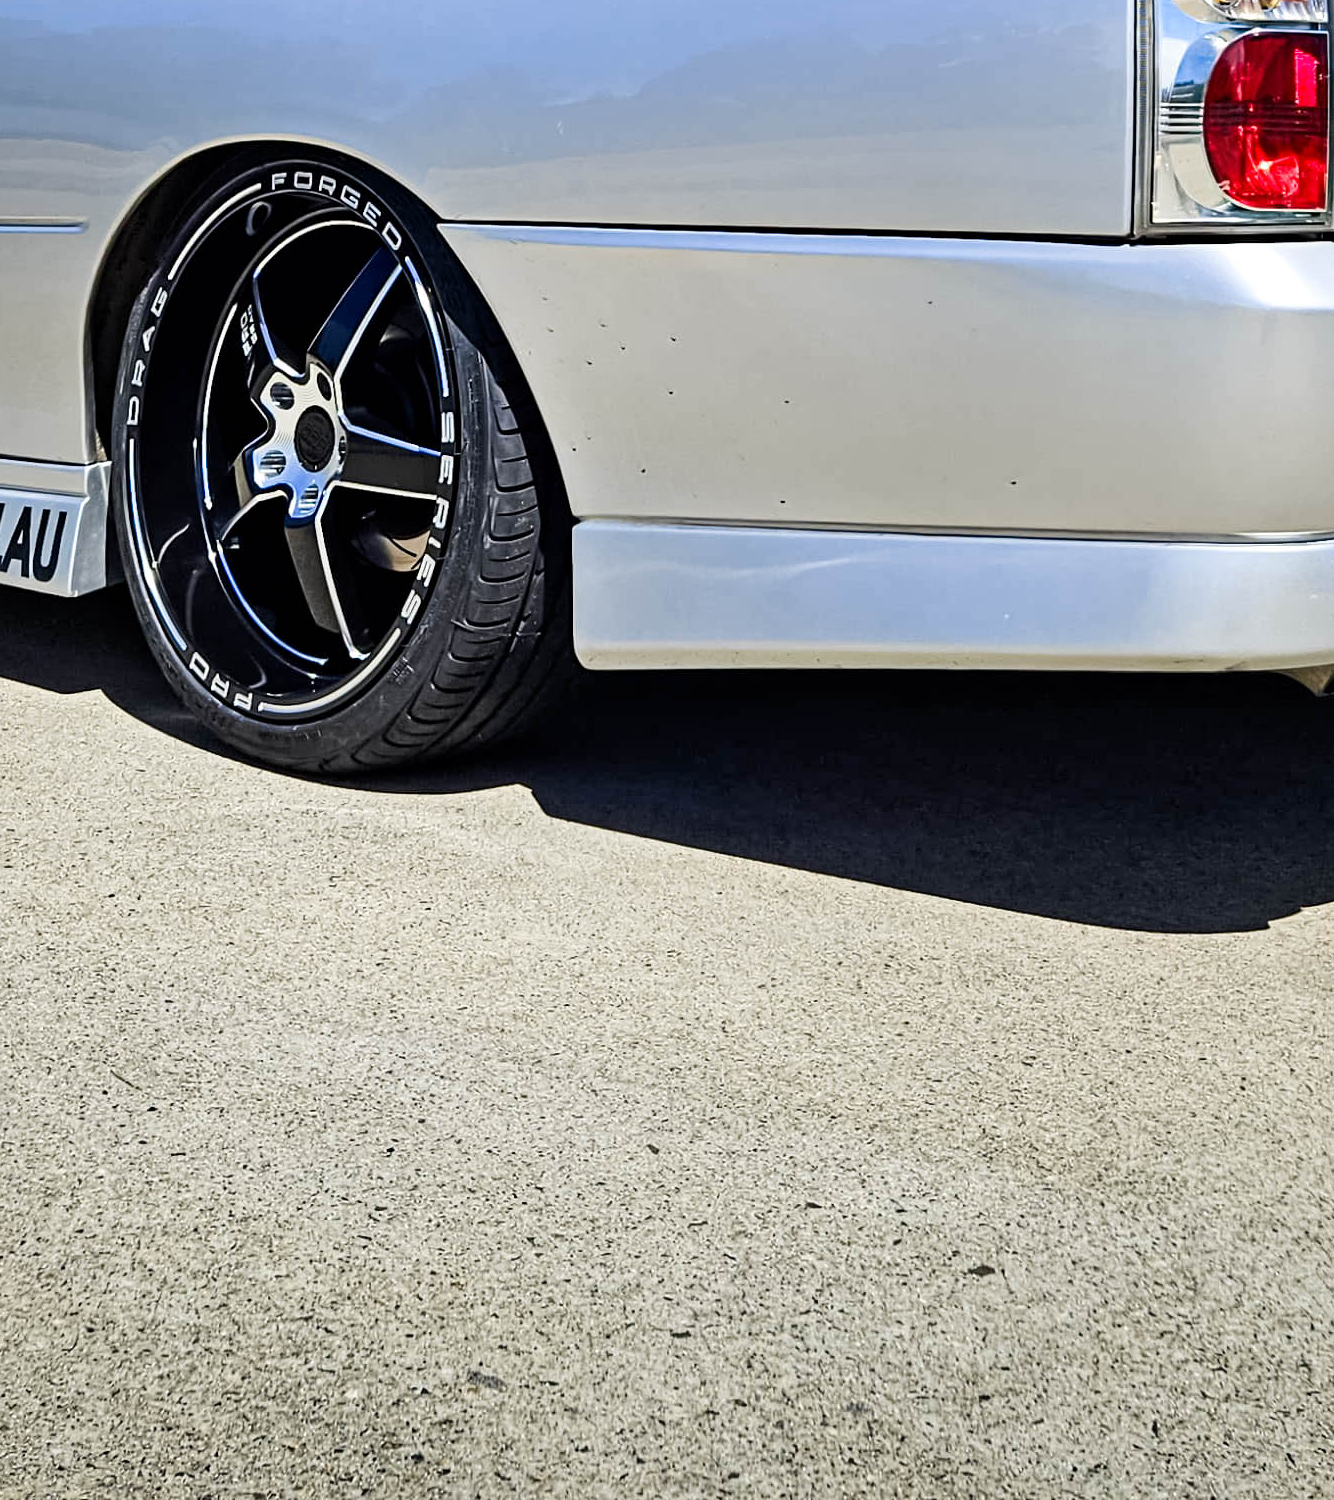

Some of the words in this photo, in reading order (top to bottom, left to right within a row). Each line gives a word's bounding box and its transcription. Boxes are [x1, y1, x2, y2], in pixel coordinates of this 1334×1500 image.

[271, 170, 404, 252] FORGED
[126, 288, 168, 427] DRAG
[399, 410, 458, 626] SERIES
[189, 653, 255, 712] PRO
